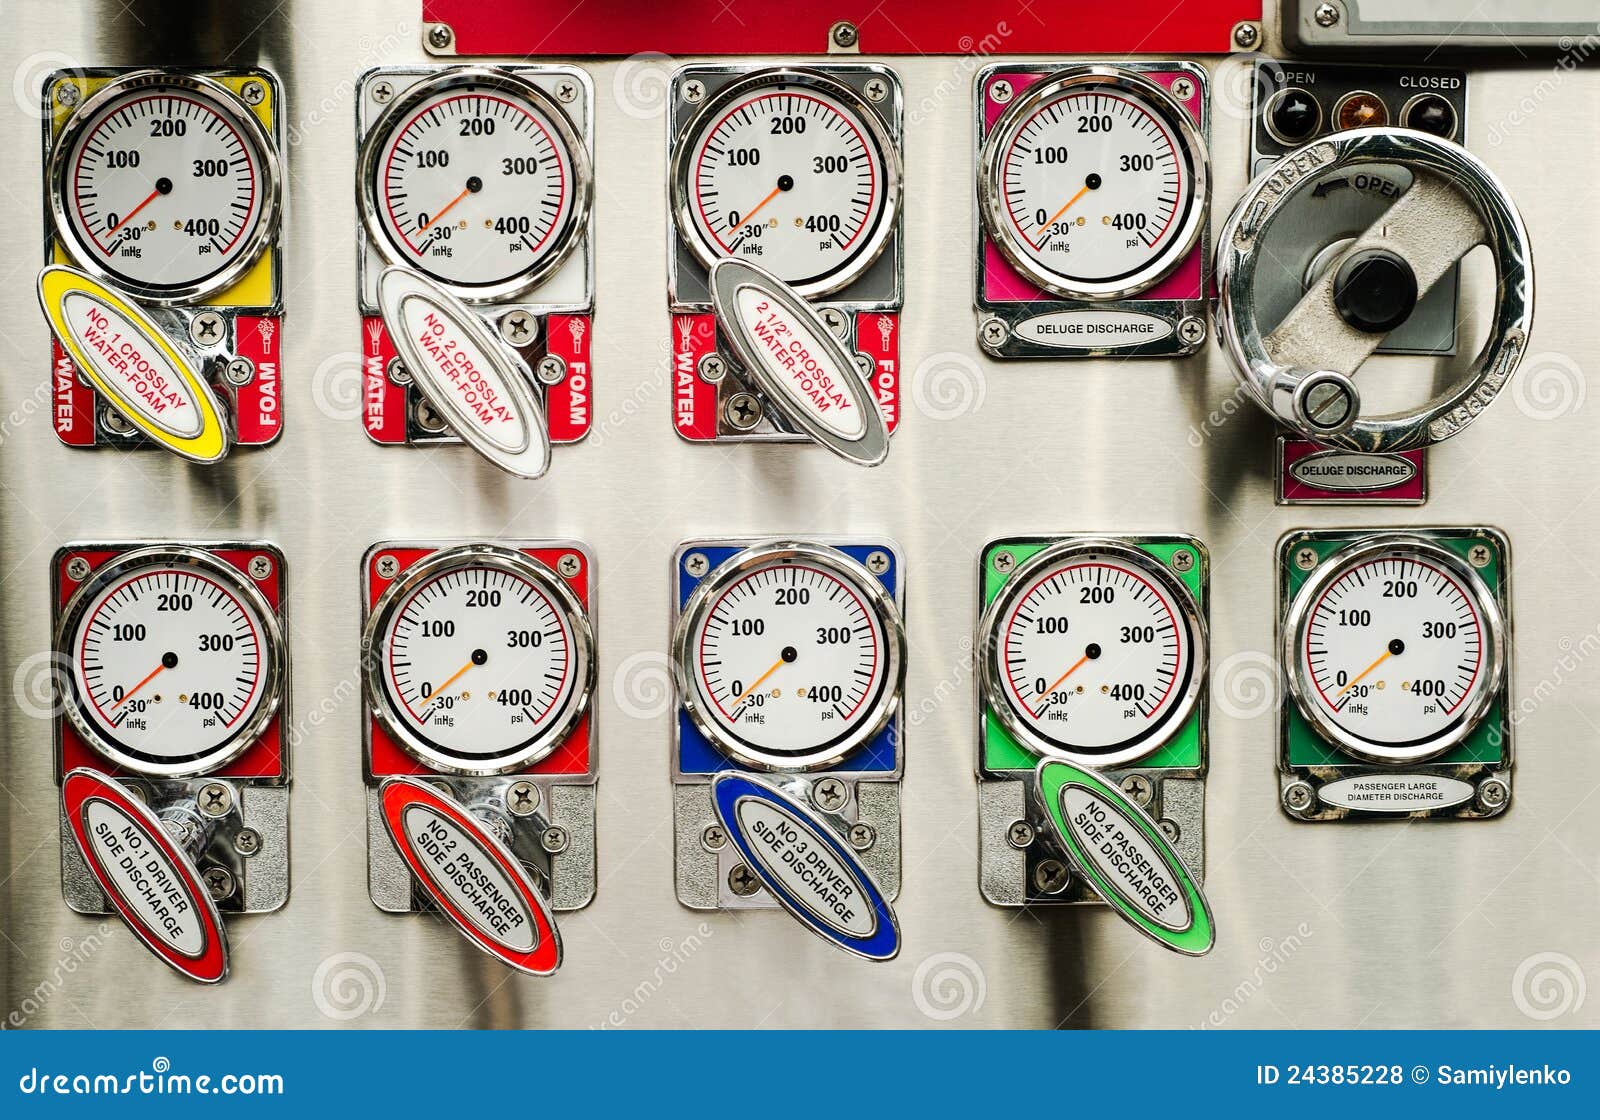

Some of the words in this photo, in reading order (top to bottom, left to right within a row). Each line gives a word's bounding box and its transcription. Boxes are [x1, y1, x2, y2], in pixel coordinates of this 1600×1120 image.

[1274, 71, 1315, 84] OPEN
[1399, 76, 1461, 89] CLOSED
[150, 119, 186, 137] 200
[459, 118, 495, 136] 200
[770, 116, 806, 134] 200
[1077, 115, 1113, 133] 200
[106, 150, 140, 168] 100
[416, 150, 450, 168] 100
[727, 148, 761, 166] 100
[812, 155, 848, 173] 300
[1034, 146, 1068, 164] 100
[1118, 154, 1154, 172] 300
[192, 159, 228, 177] 300
[501, 157, 537, 175] 300
[1267, 147, 1325, 196] OPEN
[106, 212, 119, 230] 0
[417, 212, 430, 230] 0
[494, 217, 529, 235] 400
[727, 210, 740, 228] 0
[805, 215, 840, 233] 400
[1035, 208, 1048, 226] 0
[1111, 213, 1146, 231] 400
[184, 219, 219, 237] 400
[121, 246, 142, 258] inHg
[198, 244, 212, 255] psi
[432, 245, 453, 257] inHg
[509, 242, 523, 253] psi
[742, 243, 763, 255] inHg
[819, 240, 833, 251] psi
[1050, 241, 1071, 253] inHg
[1125, 238, 1139, 249] psi
[1036, 324, 1083, 335] DELUGE
[1086, 323, 1155, 334] DISCHARGE
[86, 308, 108, 334] NO.
[119, 340, 187, 409] CROSSLAY
[756, 302, 769, 314] 2
[790, 340, 852, 410] CROSSLAY
[83, 326, 167, 414] WATER-FOAM
[423, 312, 445, 340] NO.
[445, 340, 457, 352] 2
[453, 352, 515, 424] CROSSLAY
[753, 320, 832, 413] WATER-FOAM
[419, 331, 494, 425] WATER-FOAM
[58, 357, 73, 433] WATER
[259, 362, 276, 426] FOAM
[367, 356, 384, 431] WATER
[569, 362, 586, 425] FOAM
[678, 352, 694, 427] WATER
[879, 360, 894, 421] FOAM
[1302, 466, 1344, 476] DELUGE
[1346, 466, 1407, 476] DISCHARGE
[774, 587, 810, 605] 200
[1079, 586, 1115, 604] 200
[1382, 580, 1418, 598] 200
[157, 594, 193, 612] 200
[465, 590, 501, 608] 200
[731, 618, 765, 636] 100
[1035, 616, 1069, 634] 100
[1338, 609, 1372, 627] 100
[112, 623, 146, 641] 100
[421, 620, 455, 638] 100
[815, 626, 851, 644] 300
[1119, 625, 1155, 643] 300
[1421, 621, 1457, 639] 300
[198, 634, 234, 652] 300
[506, 630, 542, 648] 300
[1034, 677, 1047, 695] 0
[1335, 669, 1348, 687] 0
[112, 684, 125, 702] 0
[420, 681, 433, 699] 0
[730, 679, 743, 697] 0
[807, 686, 842, 704] 400
[1110, 684, 1145, 702] 400
[1410, 680, 1445, 698] 400
[189, 692, 224, 710] 400
[497, 689, 532, 707] 400
[745, 712, 766, 724] inHg
[821, 710, 835, 721] psi
[1048, 710, 1069, 722] inHg
[1123, 708, 1137, 719] psi
[1348, 703, 1369, 715] inHg
[1423, 704, 1437, 715] psi
[126, 718, 147, 730] inHg
[202, 717, 216, 728] psi
[434, 715, 455, 727] inHg
[510, 714, 524, 725] psi
[1408, 782, 1437, 790] LARGE
[1348, 793, 1391, 801] DIAMETER
[1394, 792, 1444, 800] DISCHARGE
[752, 821, 785, 854] SIDE
[781, 850, 855, 924] DISCHARGE
[1074, 812, 1104, 844] SIDE
[1100, 842, 1167, 916] DISCHARGE
[1111, 831, 1179, 905] PASSENGER
[95, 823, 125, 858] SIDE
[119, 857, 184, 940] DISCHARGE
[417, 832, 446, 864] SIDE
[443, 862, 511, 937] DISCHARGE
[805, 851, 854, 900] DRIVER
[145, 860, 189, 914] DRIVER
[456, 853, 525, 928] PASSENGER
